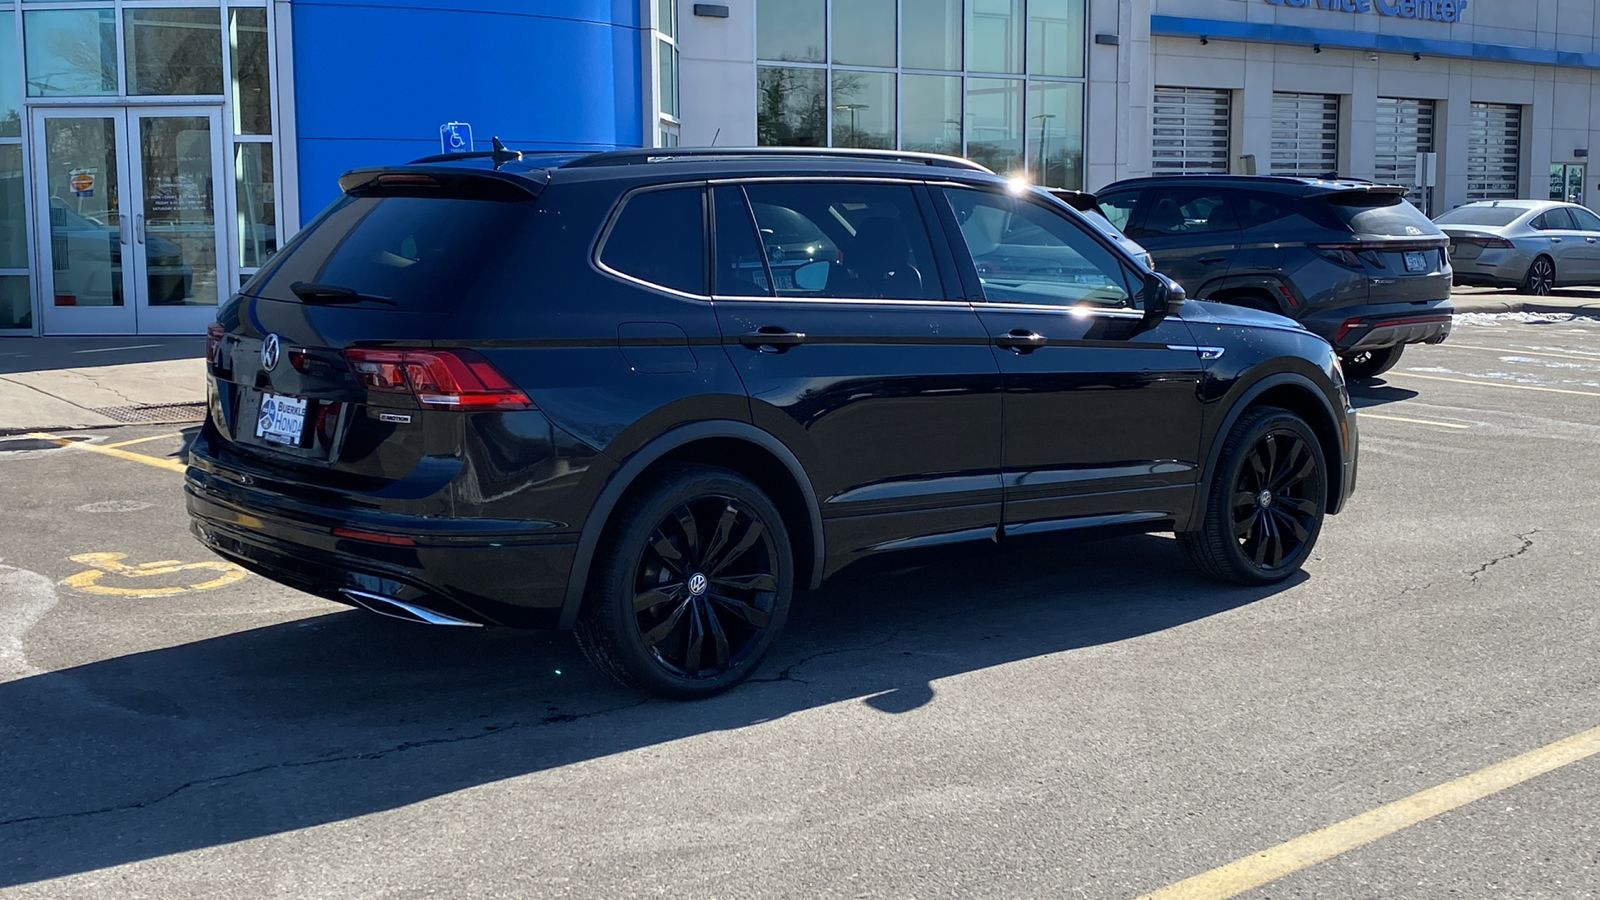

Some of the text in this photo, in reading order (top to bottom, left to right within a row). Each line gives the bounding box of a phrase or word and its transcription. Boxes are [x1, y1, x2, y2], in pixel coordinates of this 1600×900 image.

[1264, 0, 1467, 22] vice Center
[278, 401, 306, 416] BUERKLE
[274, 412, 302, 434] HONDA
